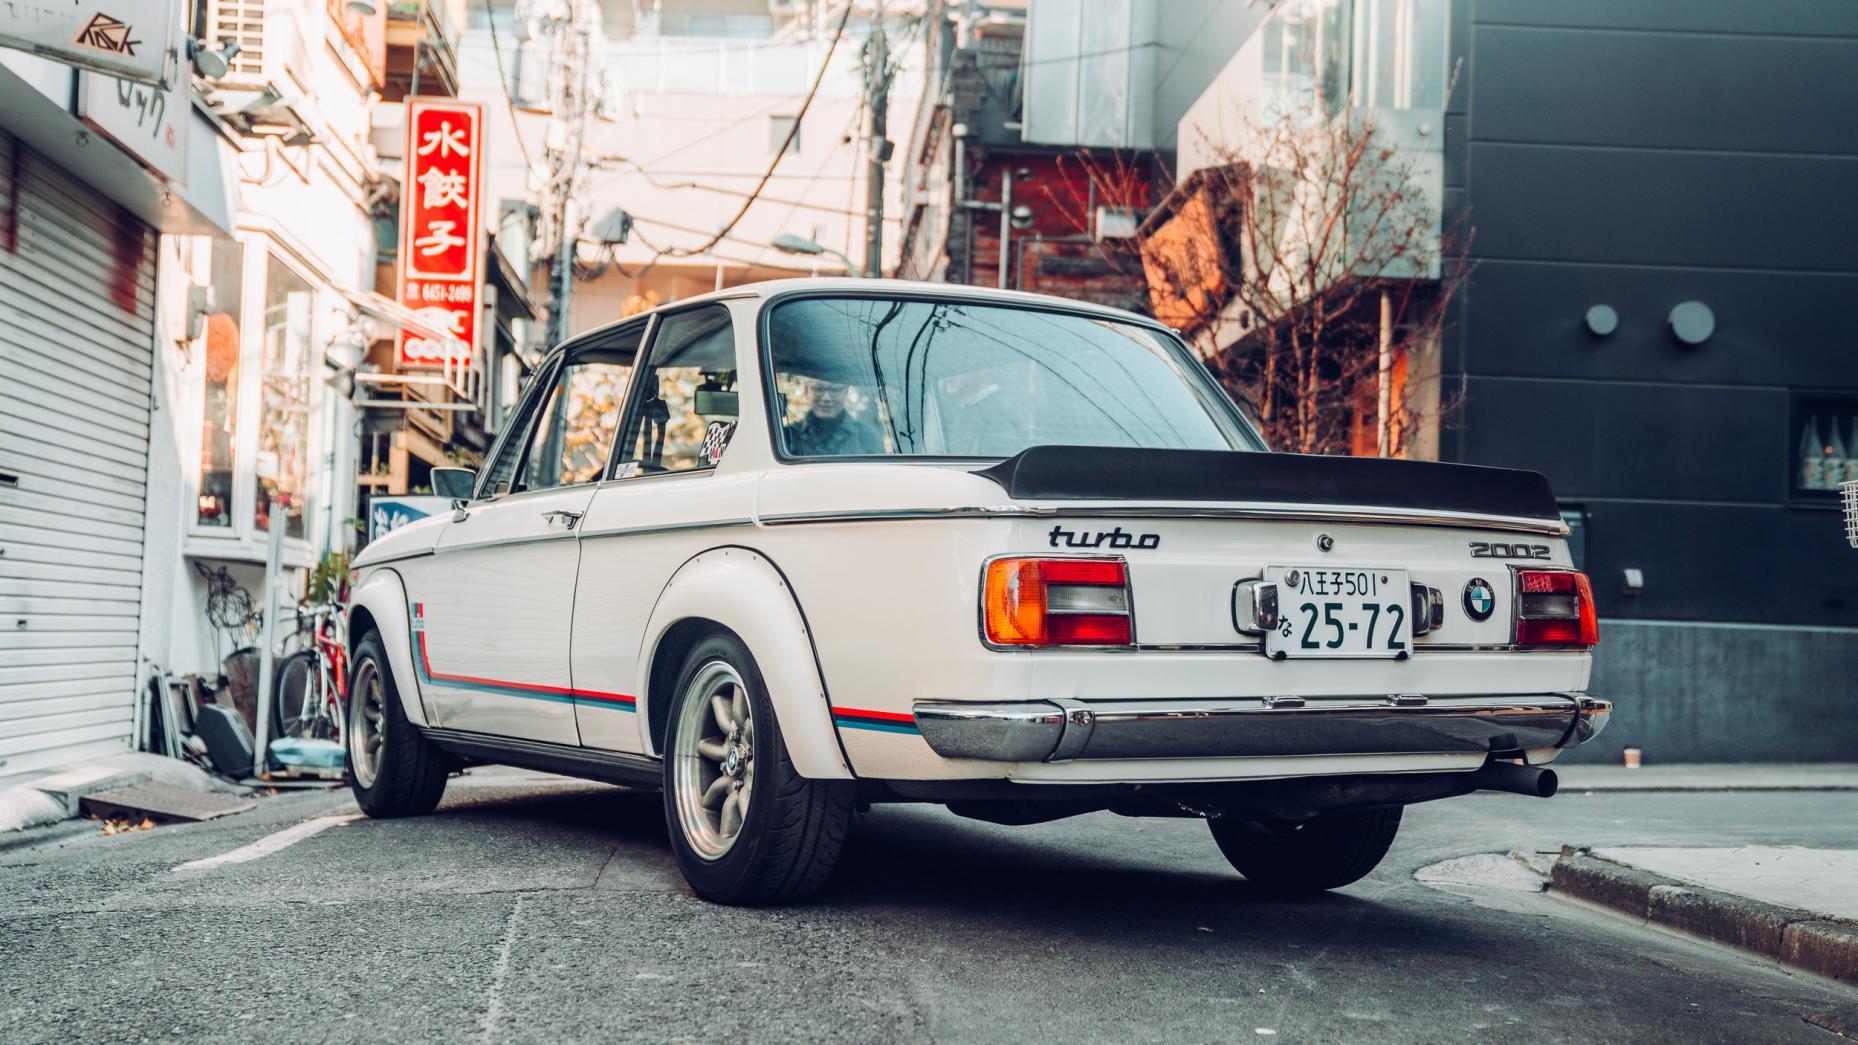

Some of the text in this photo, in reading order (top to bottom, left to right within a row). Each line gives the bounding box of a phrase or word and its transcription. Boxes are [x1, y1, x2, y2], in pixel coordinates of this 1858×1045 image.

[414, 120, 470, 257] 水餃子
[1048, 525, 1161, 550] turbo
[1468, 541, 1552, 561] 2002
[1299, 571, 1377, 597] 八王子501
[1277, 602, 1406, 650] な 25-72
